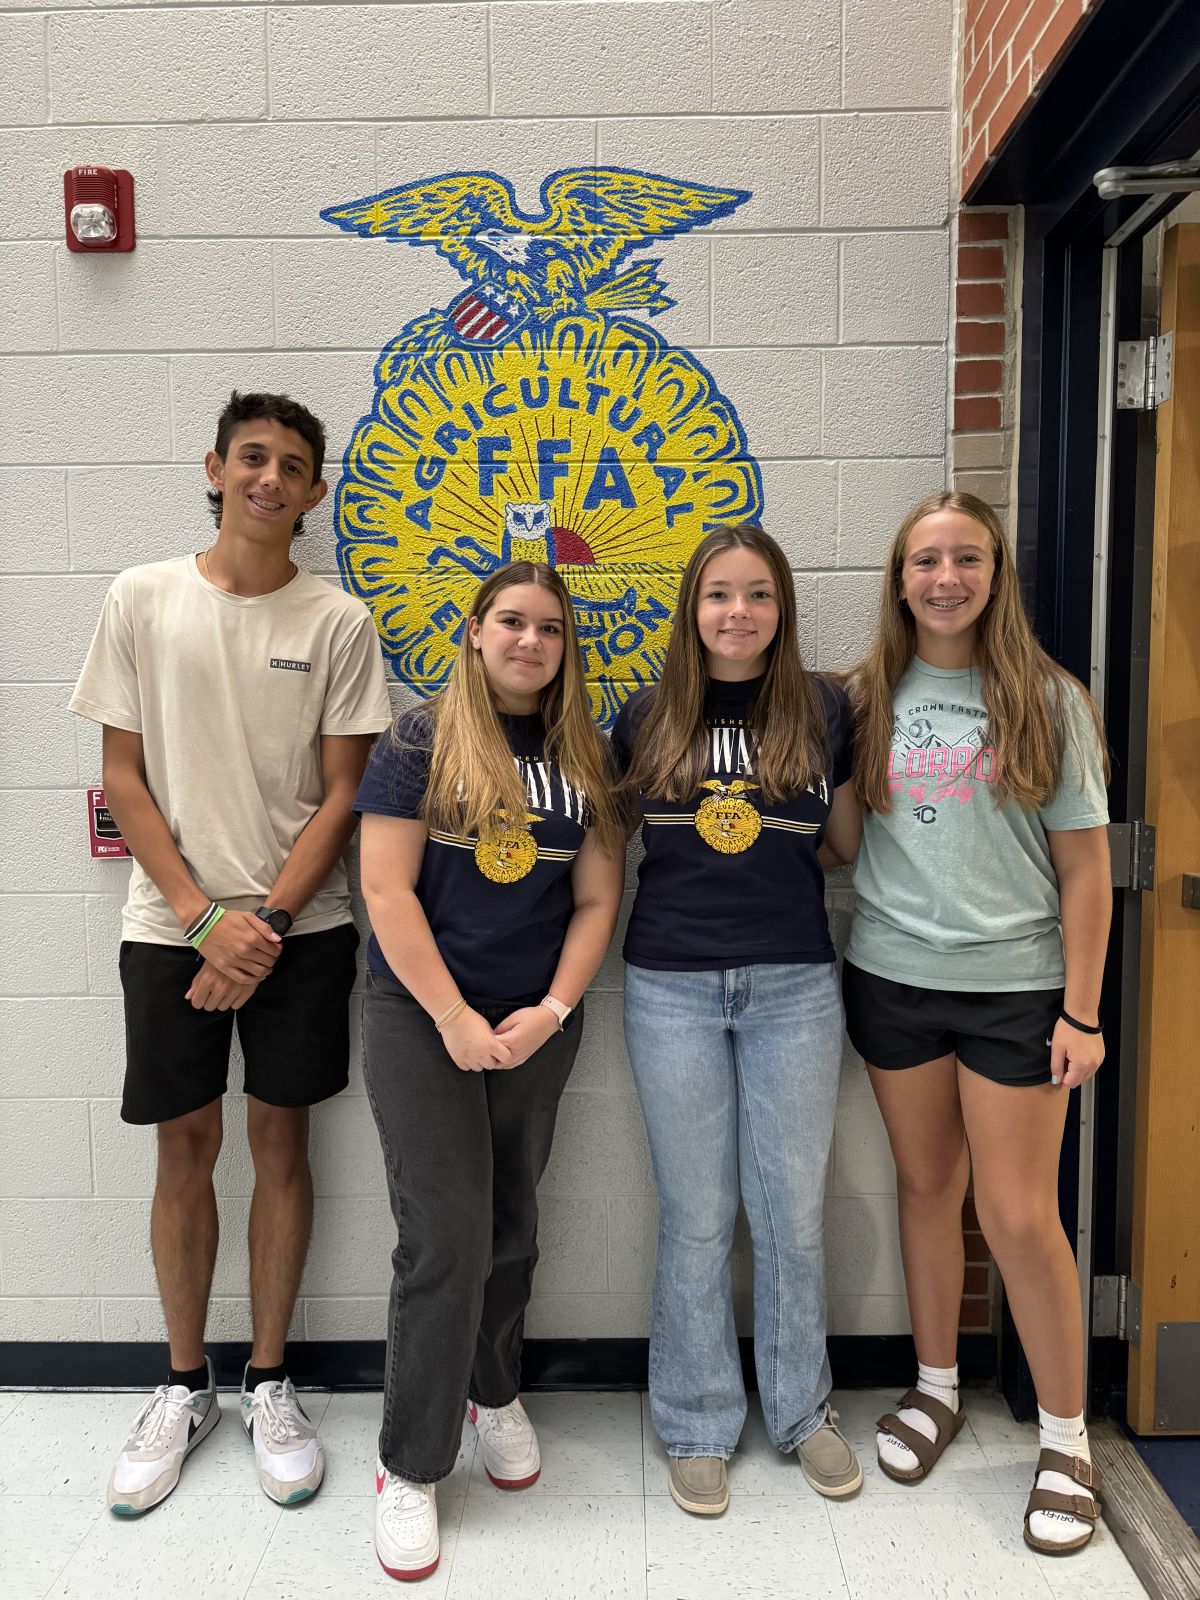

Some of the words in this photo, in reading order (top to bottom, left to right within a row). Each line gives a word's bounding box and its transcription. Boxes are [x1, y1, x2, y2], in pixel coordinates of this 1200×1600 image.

[78, 168, 98, 176] FIRE
[405, 376, 694, 531] AGRICULTURAL
[477, 435, 636, 511] FFA
[280, 661, 311, 671] HURLEY
[908, 703, 944, 716] CROWN
[951, 704, 987, 719] FASTP
[887, 746, 998, 782] LORAD
[716, 811, 742, 819] FFA
